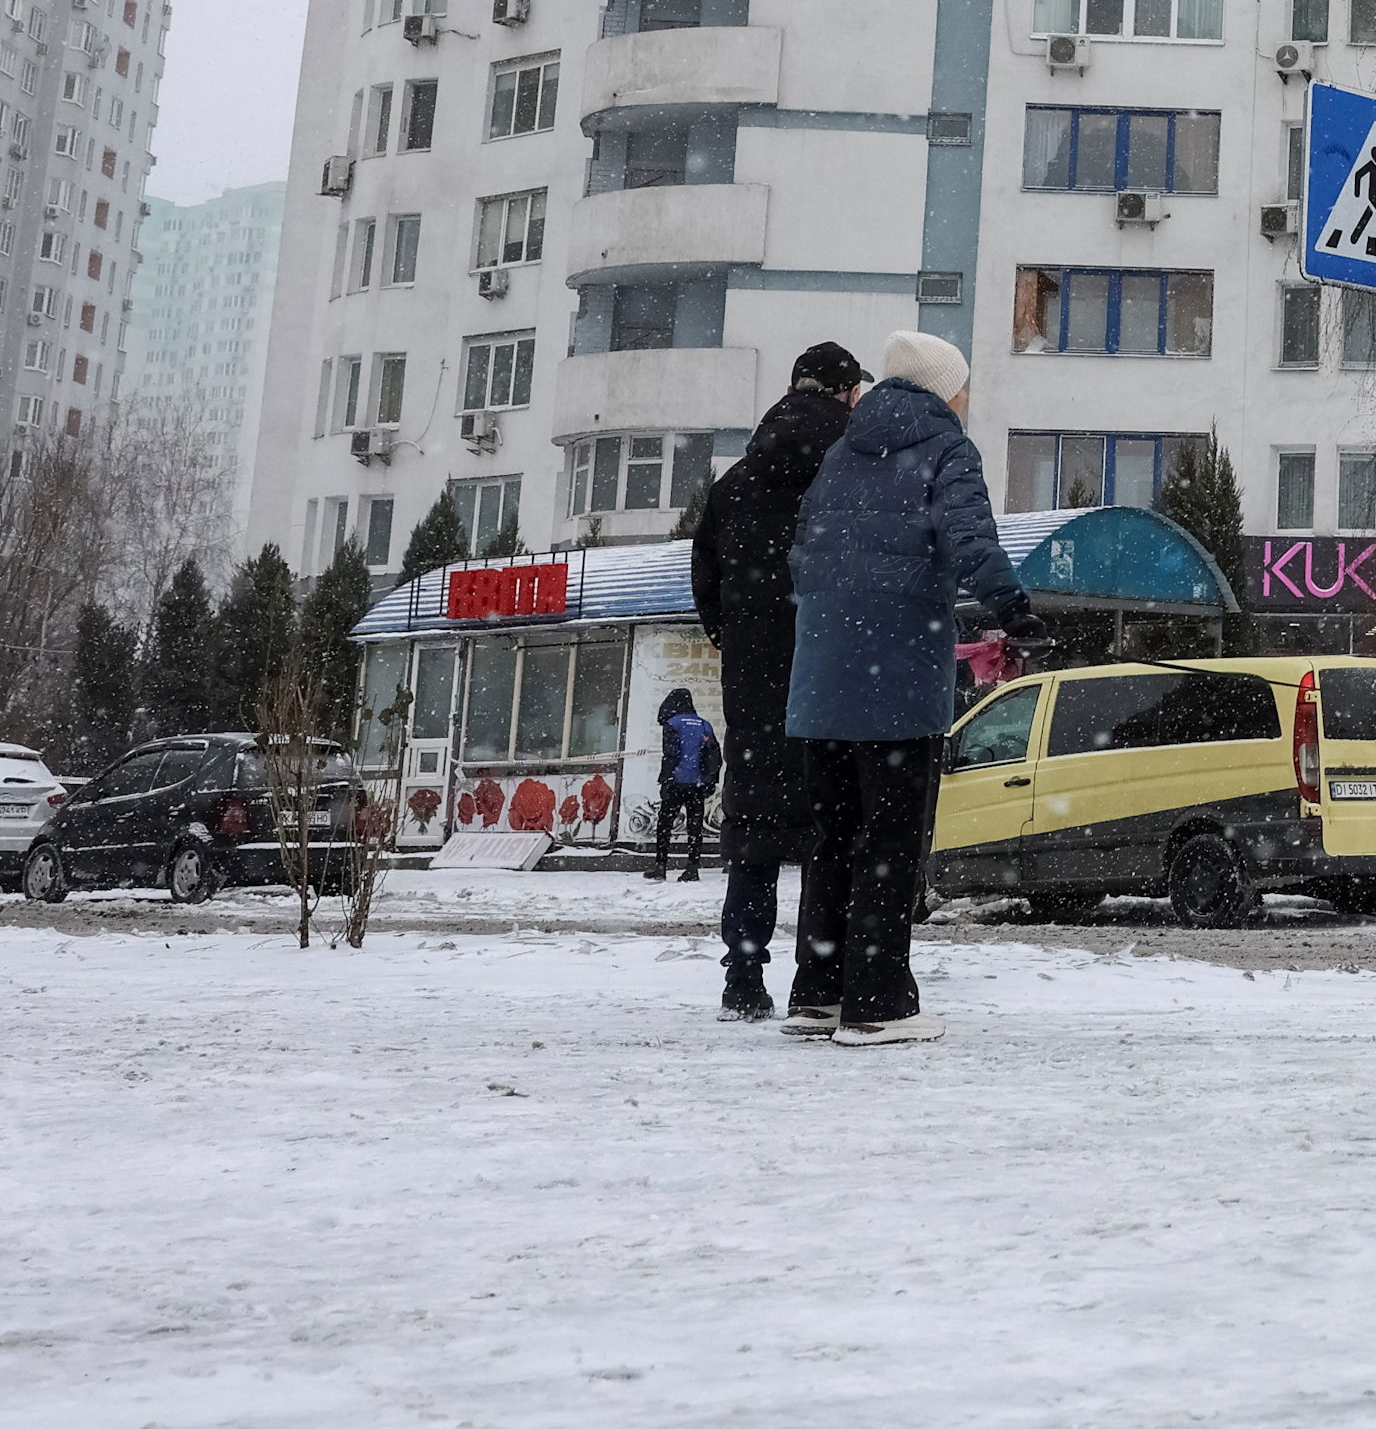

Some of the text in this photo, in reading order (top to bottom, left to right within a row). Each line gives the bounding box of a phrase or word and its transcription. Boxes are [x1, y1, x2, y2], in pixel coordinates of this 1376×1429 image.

[447, 564, 568, 619] КВІТИ
[1335, 784, 1347, 796] DI
[1349, 784, 1368, 796] 5032
